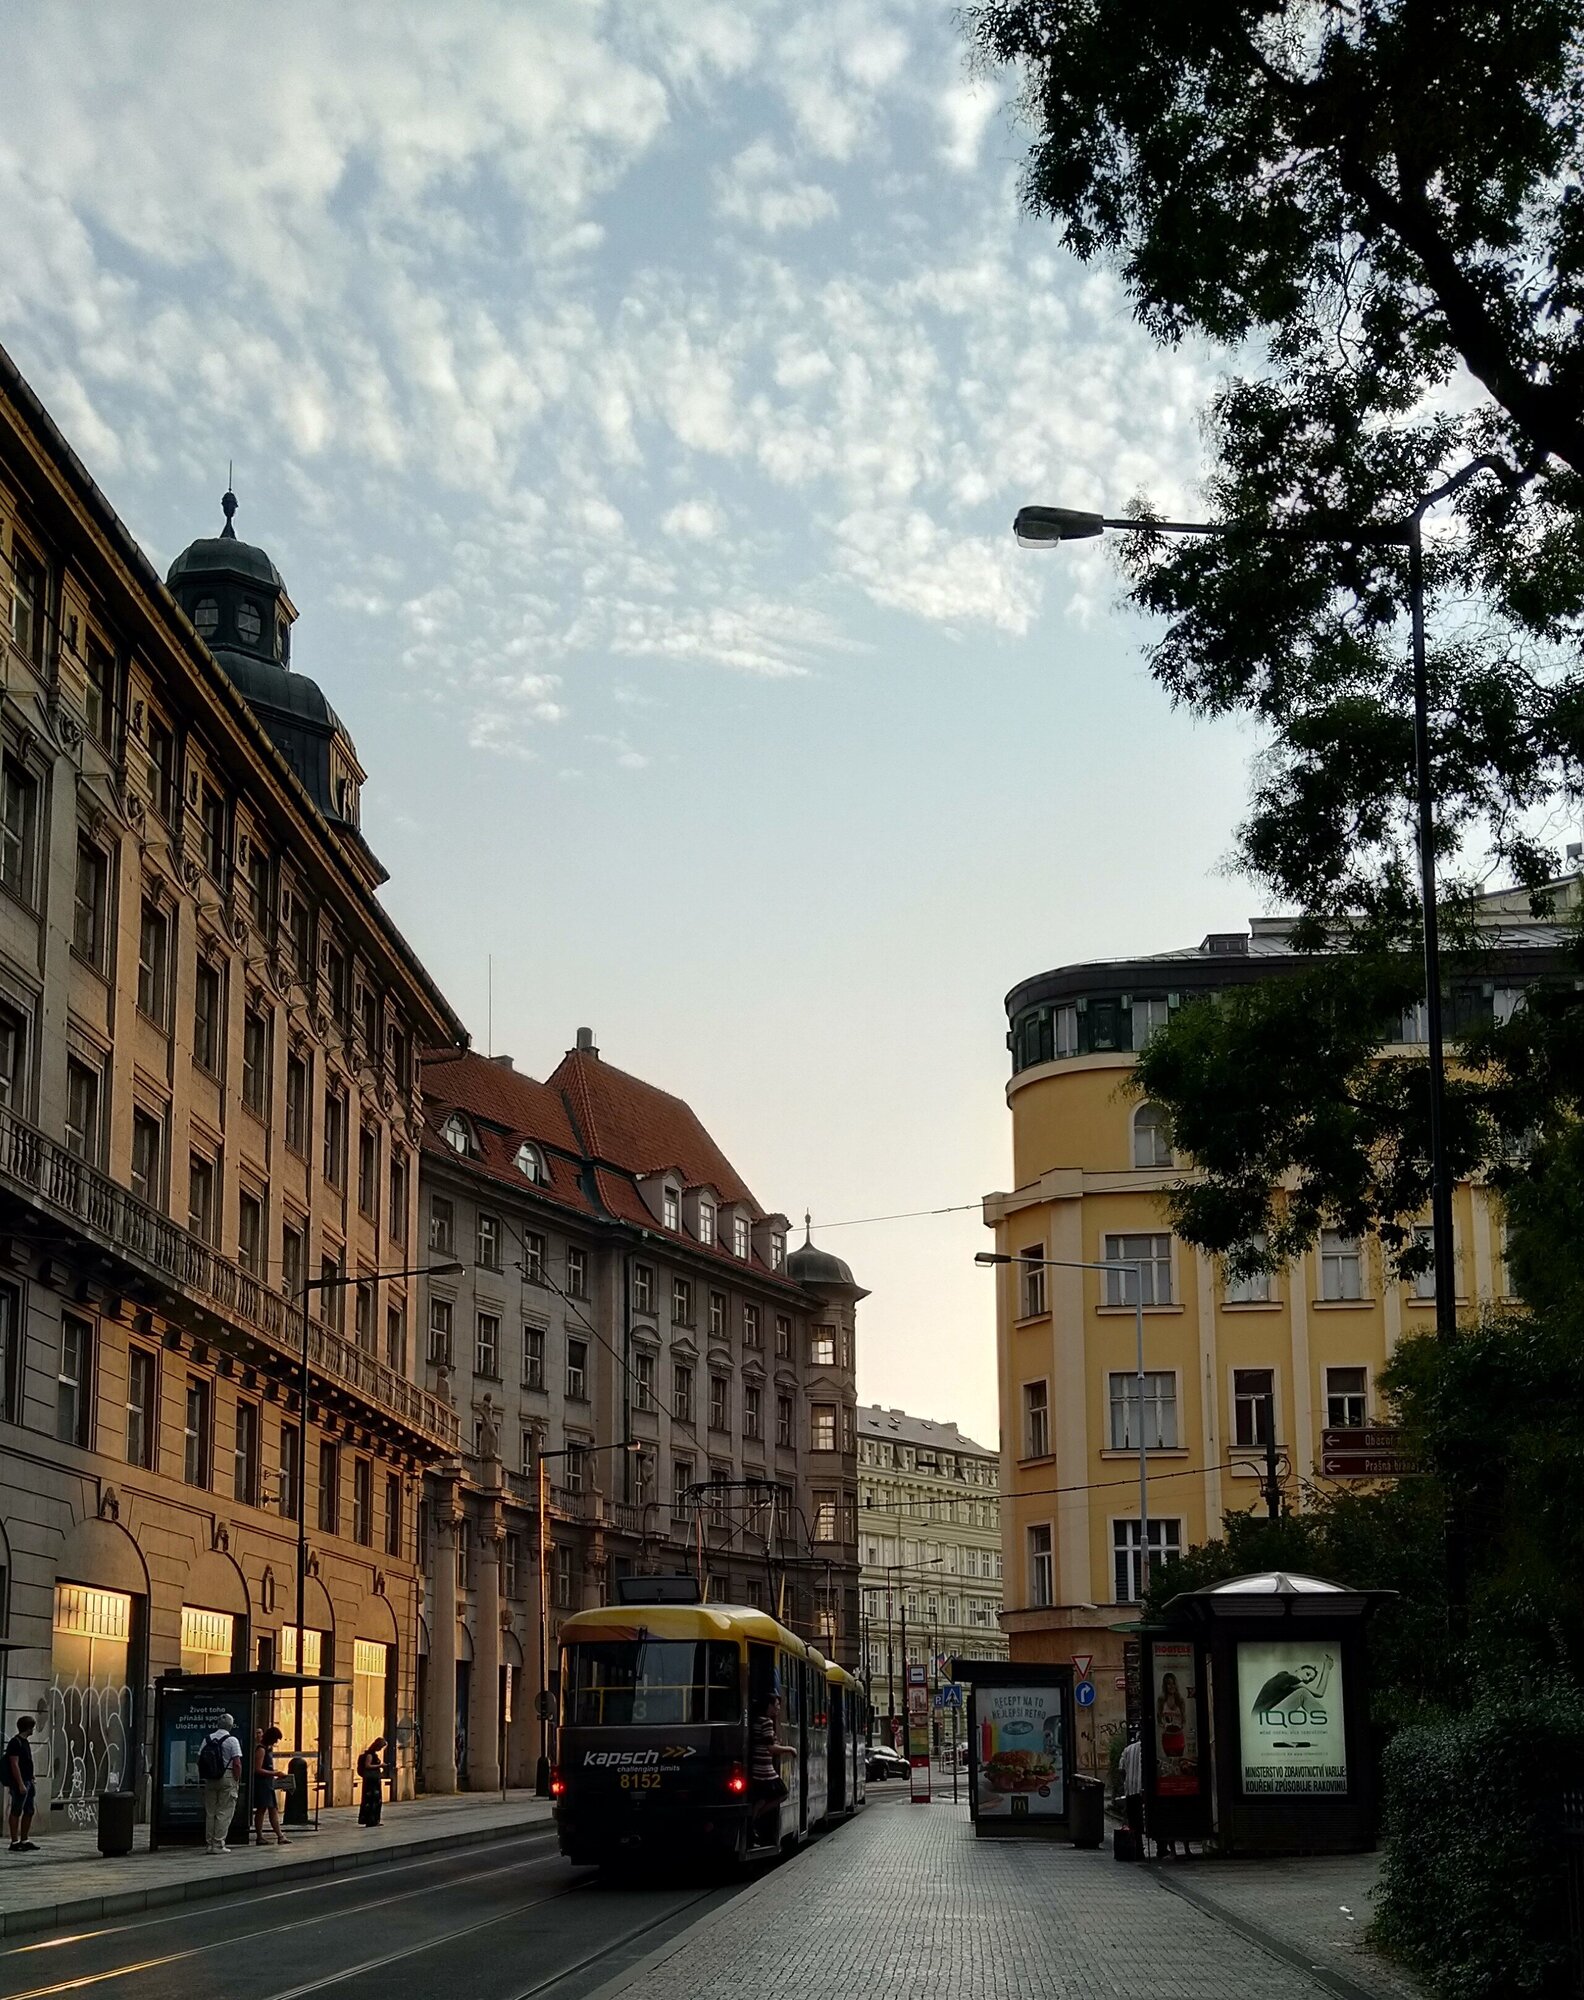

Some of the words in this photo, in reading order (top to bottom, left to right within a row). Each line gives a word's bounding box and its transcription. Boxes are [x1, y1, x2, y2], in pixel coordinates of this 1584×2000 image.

[994, 1696, 1020, 1709] RECEPT
[1023, 1696, 1032, 1706] NA
[1034, 1697, 1044, 1708] TO
[1025, 1709, 1047, 1720] RETRO
[1259, 1710, 1328, 1728] IQOS
[583, 1749, 659, 1767] kapsch
[617, 1764, 659, 1773] challenging
[660, 1764, 681, 1772] limits
[1245, 1766, 1284, 1778] MINISTERSTVO
[620, 1774, 662, 1789] 8152
[1246, 1779, 1274, 1792] KOUŘENÍ
[1275, 1779, 1312, 1792] ZPŮSOBUJE
